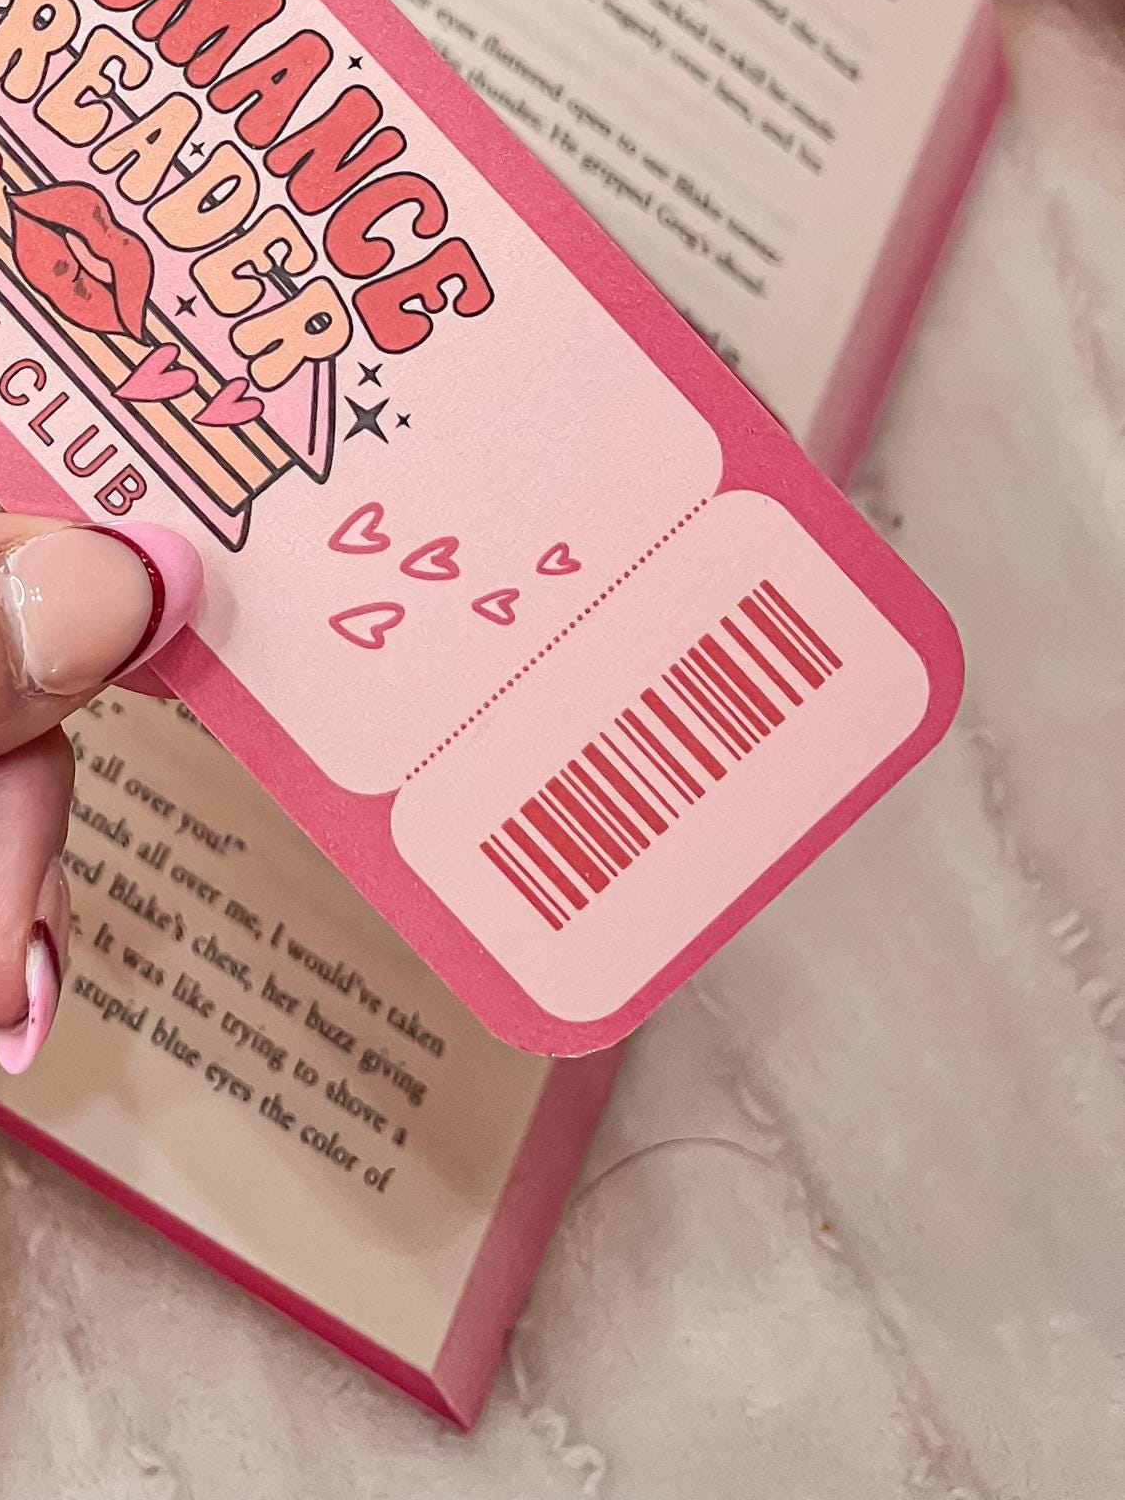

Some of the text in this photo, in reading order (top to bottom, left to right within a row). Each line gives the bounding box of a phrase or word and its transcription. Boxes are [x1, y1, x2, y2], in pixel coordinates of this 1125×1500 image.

[88, 753, 126, 786] all
[123, 778, 177, 819] over
[92, 921, 115, 955] It
[122, 946, 166, 988] was
[171, 971, 216, 1019] like
[220, 1010, 289, 1074] trying
[292, 1057, 320, 1088] to
[324, 1078, 389, 1135] shove
[391, 1127, 408, 1148] a
[107, 871, 186, 943] Blake's
[260, 970, 302, 1016] her
[303, 999, 358, 1055] buzz
[357, 1048, 428, 1108] giving
[135, 841, 172, 872] all
[169, 864, 223, 907] over
[223, 899, 263, 942] me,
[269, 921, 286, 950] I
[287, 939, 383, 1015] would've
[386, 1006, 446, 1059] taken
[71, 974, 397, 1194] stupid blue eyes the color of
